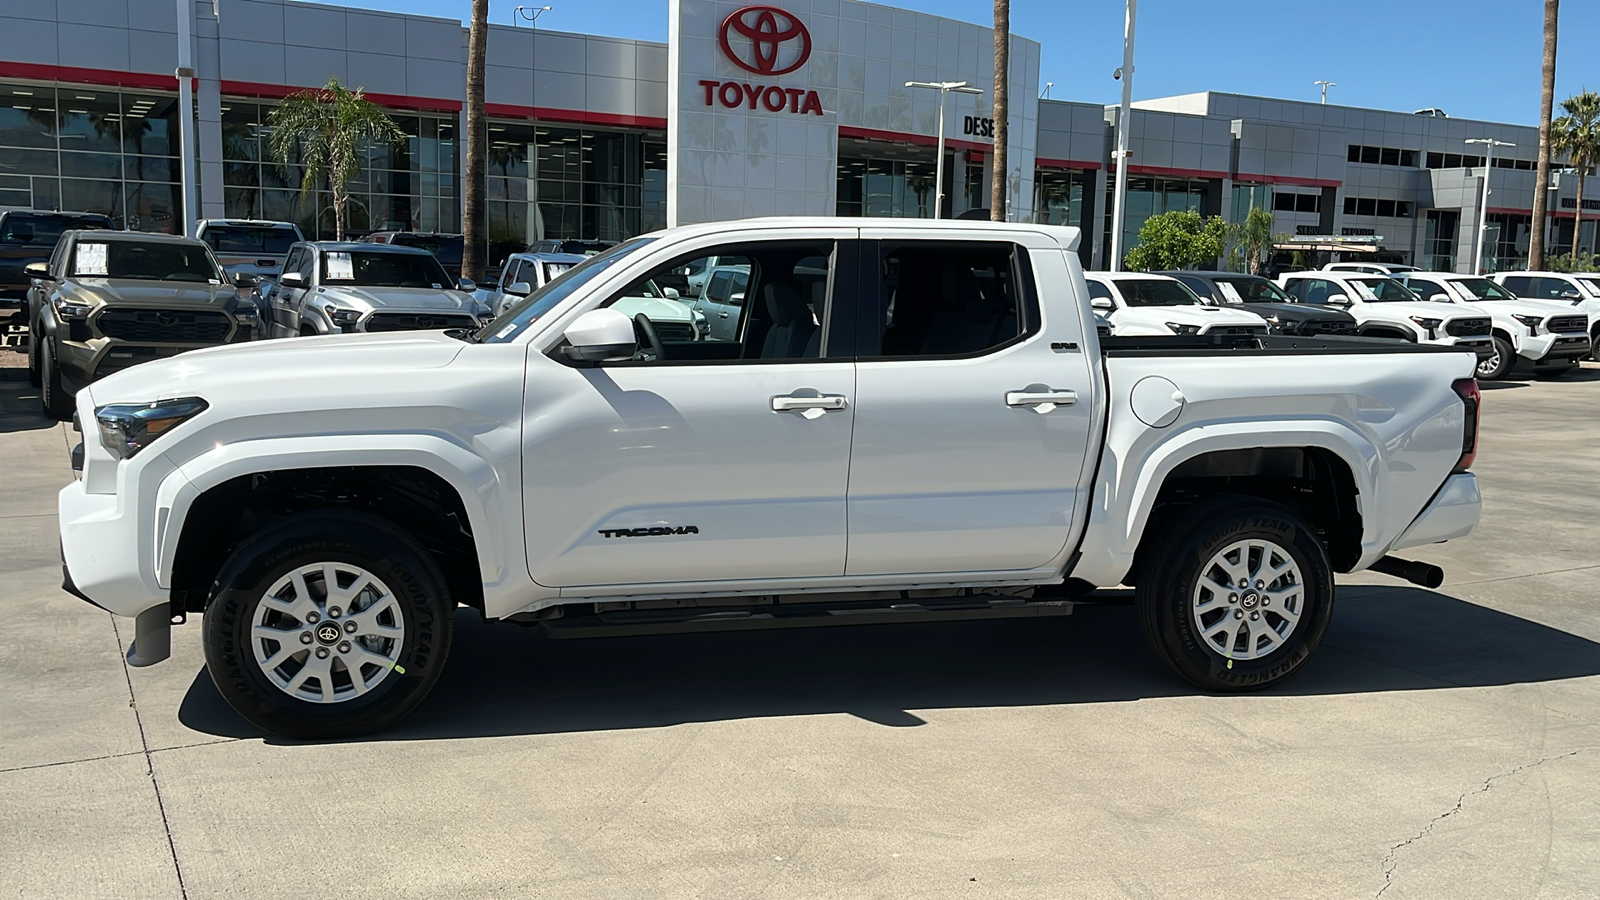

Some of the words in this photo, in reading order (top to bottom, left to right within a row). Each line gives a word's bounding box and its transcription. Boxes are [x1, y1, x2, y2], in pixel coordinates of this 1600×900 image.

[699, 80, 824, 116] TOYOTA
[964, 115, 1009, 138] DESE
[598, 526, 699, 538] TACOMA
[1217, 651, 1304, 684] WRANGLER
